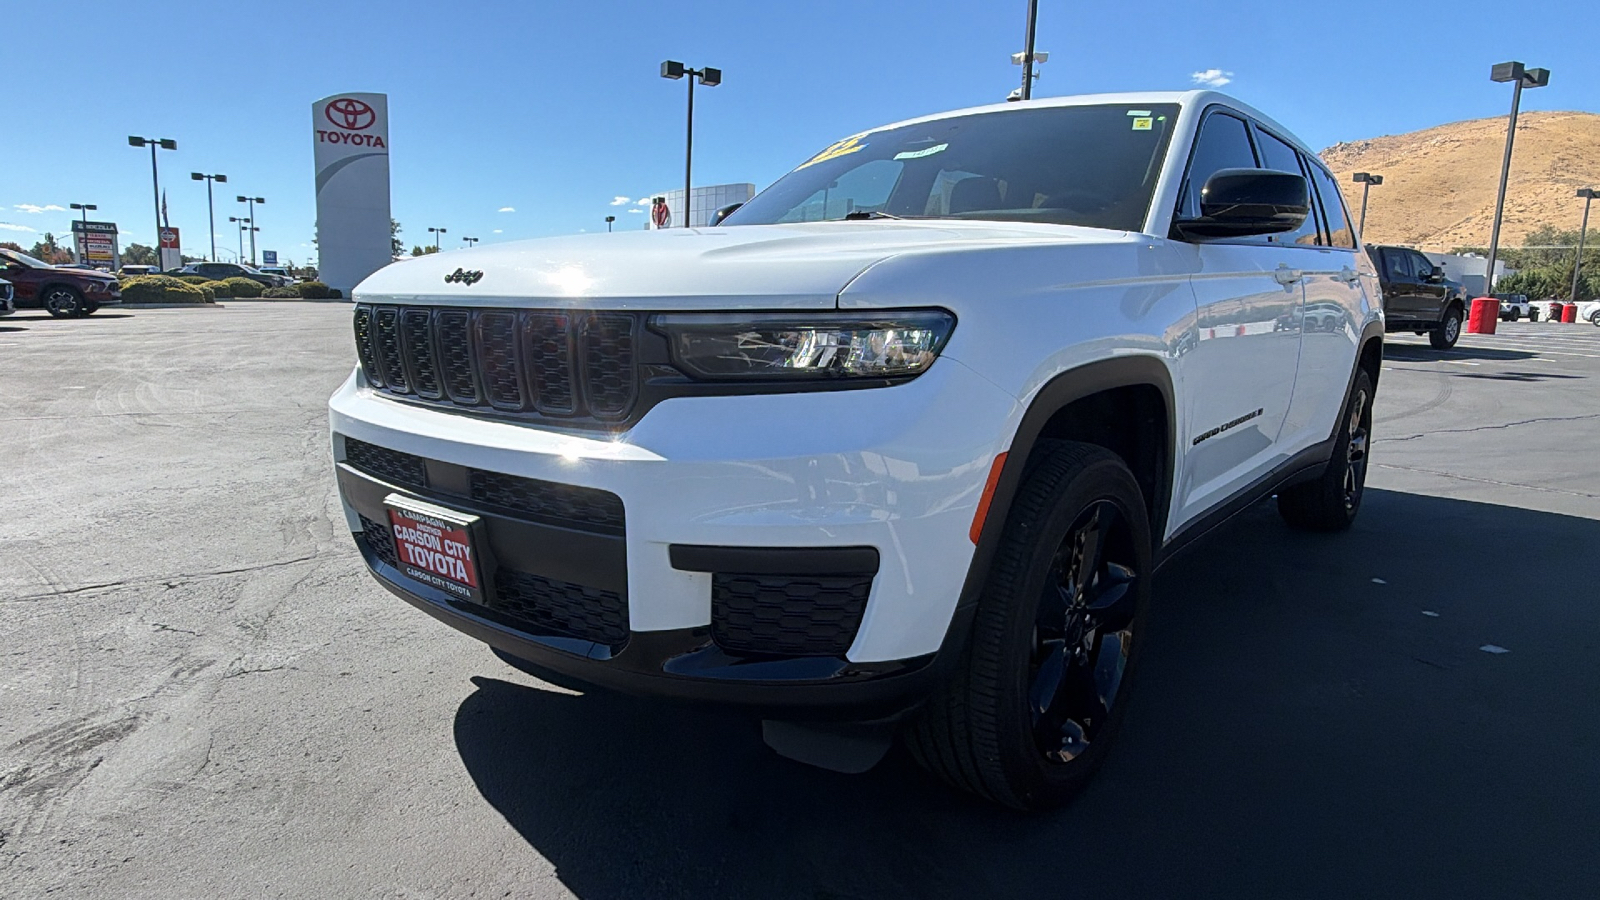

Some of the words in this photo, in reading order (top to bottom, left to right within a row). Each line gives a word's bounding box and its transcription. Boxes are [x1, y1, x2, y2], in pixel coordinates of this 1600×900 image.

[316, 130, 386, 149] TOYOTA
[444, 267, 484, 287] Jeep
[393, 524, 442, 552] CARSON
[444, 539, 471, 561] CITY
[404, 542, 469, 583] TOYOTA
[406, 567, 432, 583] CARSON
[431, 576, 446, 588] CITY
[446, 581, 471, 597] TOYOTA
